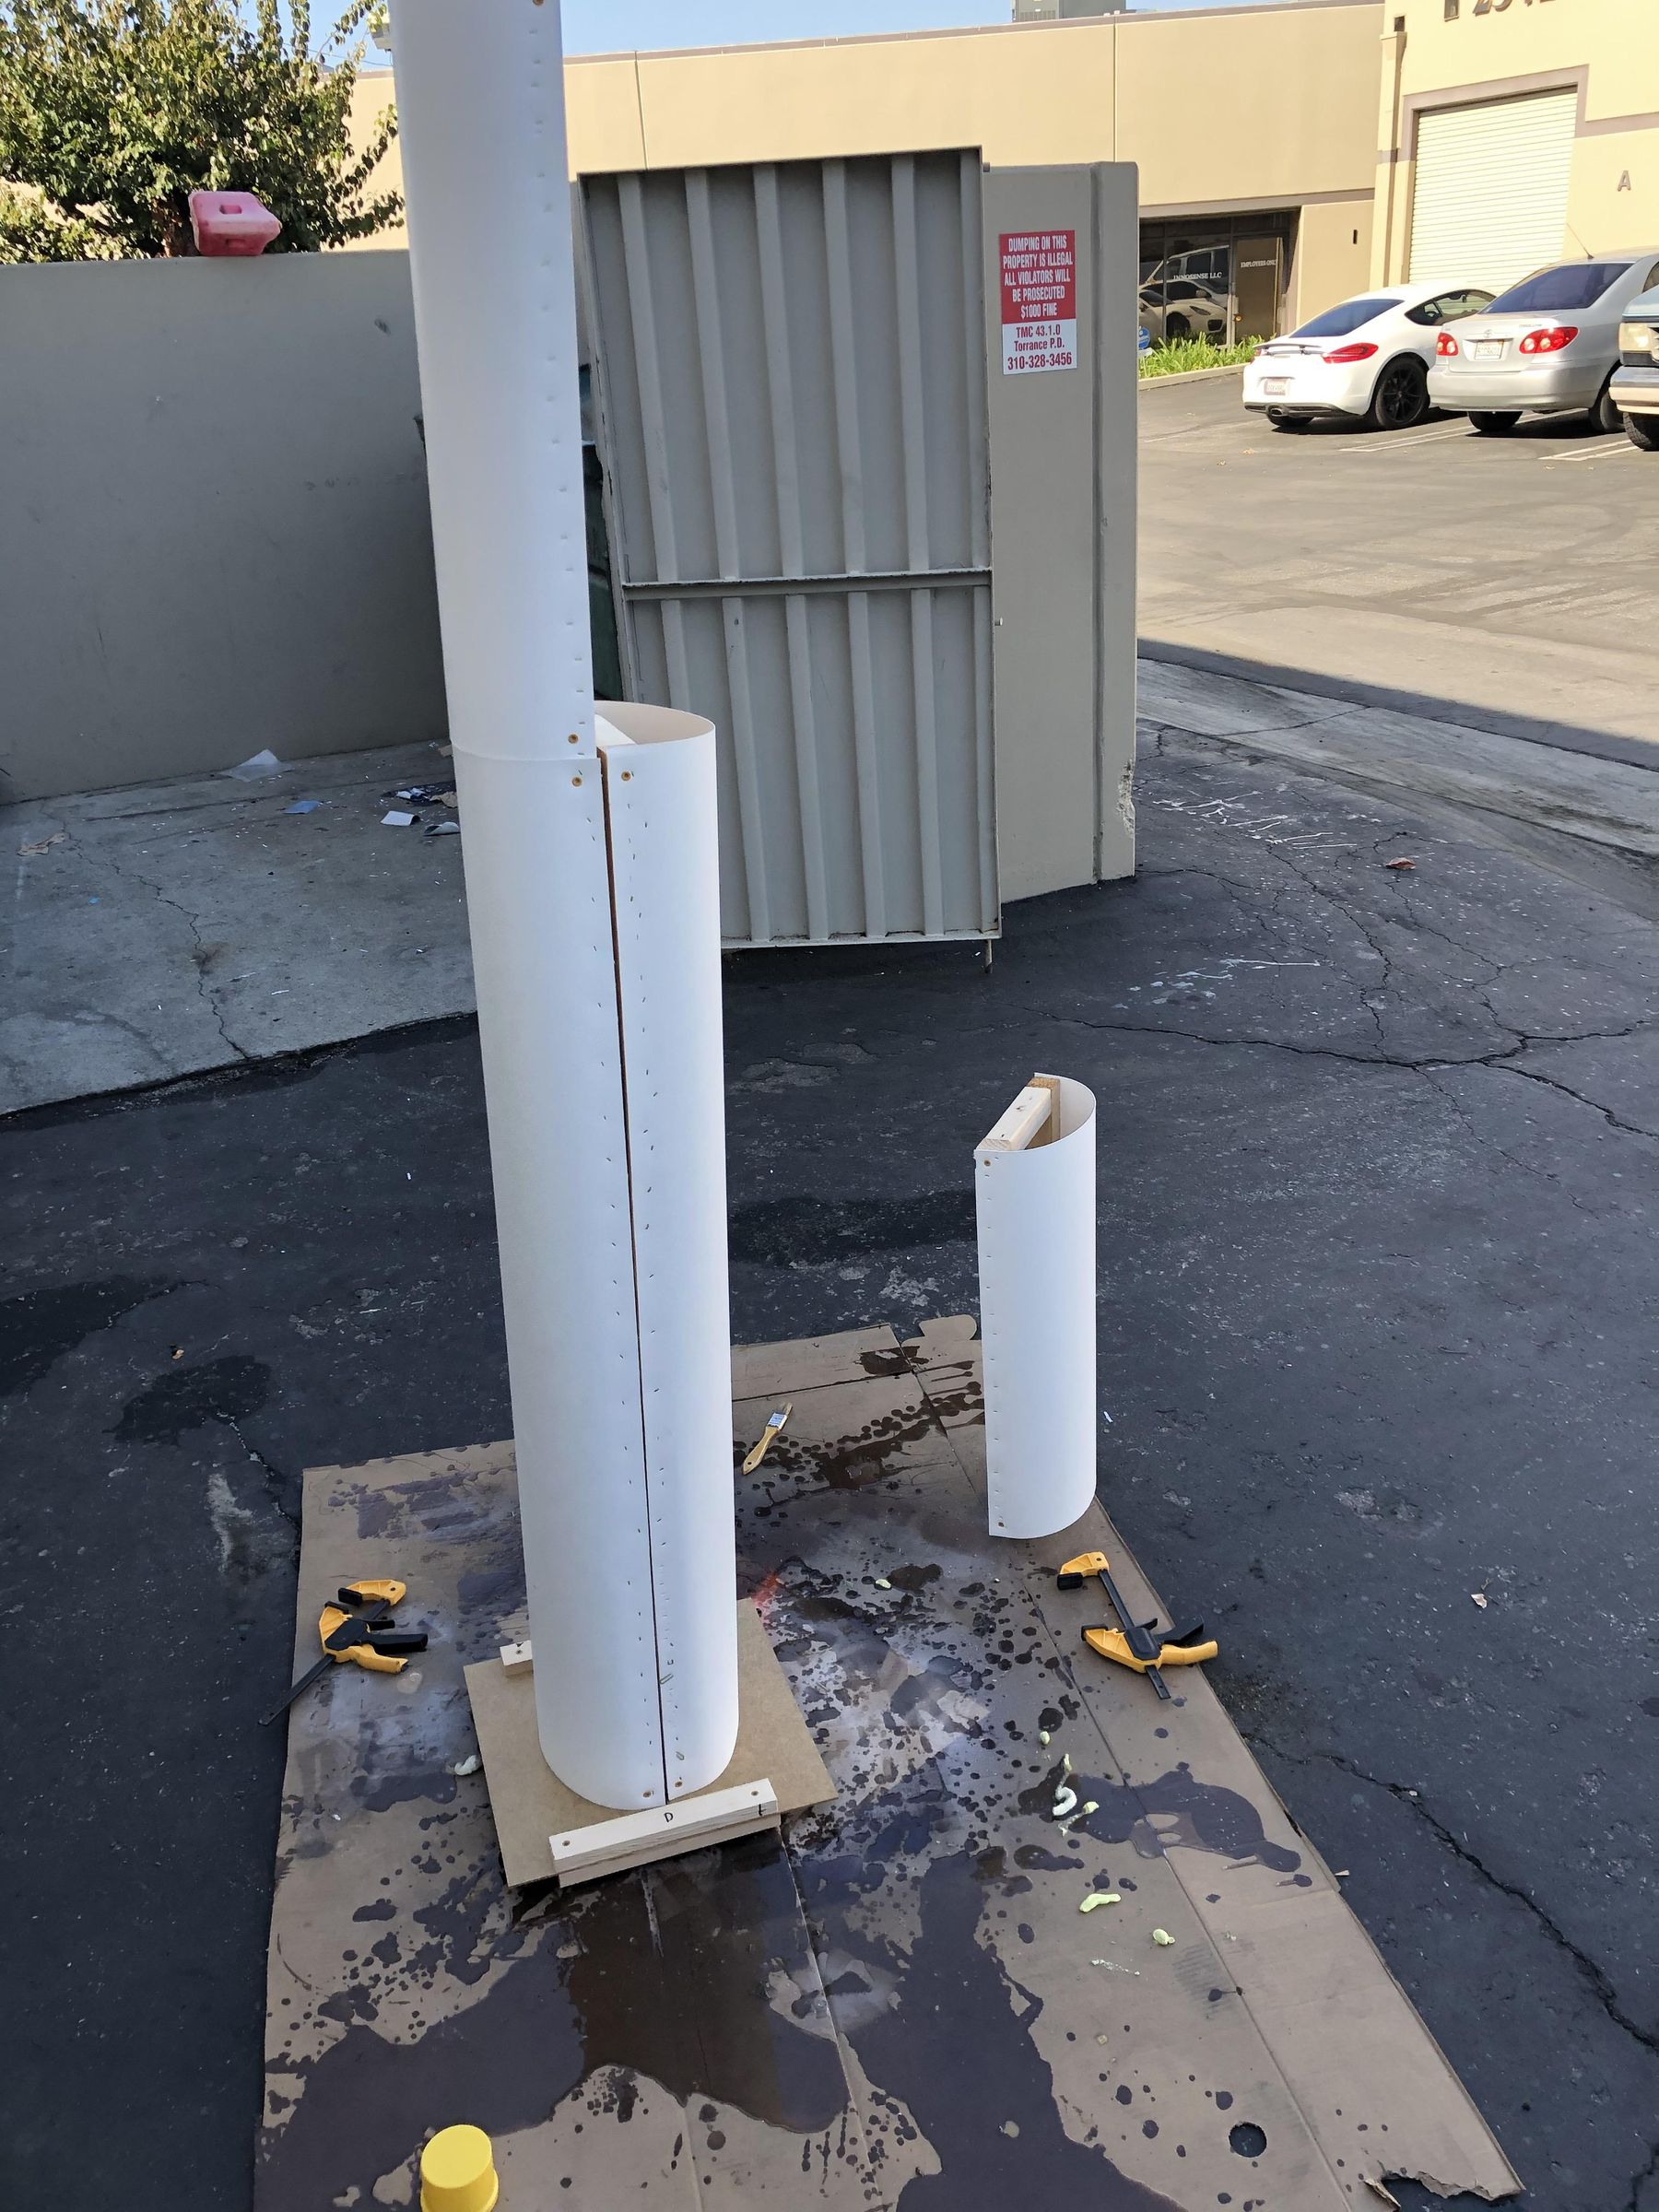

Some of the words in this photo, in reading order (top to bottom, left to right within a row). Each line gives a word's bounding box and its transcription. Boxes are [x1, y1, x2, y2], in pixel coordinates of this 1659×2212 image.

[1617, 170, 1631, 192] A
[1008, 237, 1040, 252] DUMPING
[1041, 236, 1051, 250] ON
[1052, 235, 1067, 249] THIS
[1003, 253, 1038, 269] PROPERTY
[1039, 253, 1046, 267] IS
[1047, 252, 1073, 266] ILLEGAL
[1004, 271, 1017, 287] ALL
[1018, 270, 1053, 286] VIOLATORS
[1054, 268, 1070, 283] WILL
[1012, 288, 1021, 302] BE
[1022, 285, 1065, 301] PROSECUTED
[1020, 303, 1041, 319] $1000
[1042, 302, 1057, 317] FINE
[1016, 325, 1033, 338] TMC
[1035, 324, 1061, 336] 43.1.0
[1014, 340, 1048, 352] Torrance
[1050, 337, 1065, 349] P.D.
[1007, 352, 1072, 371] 310-328-3456
